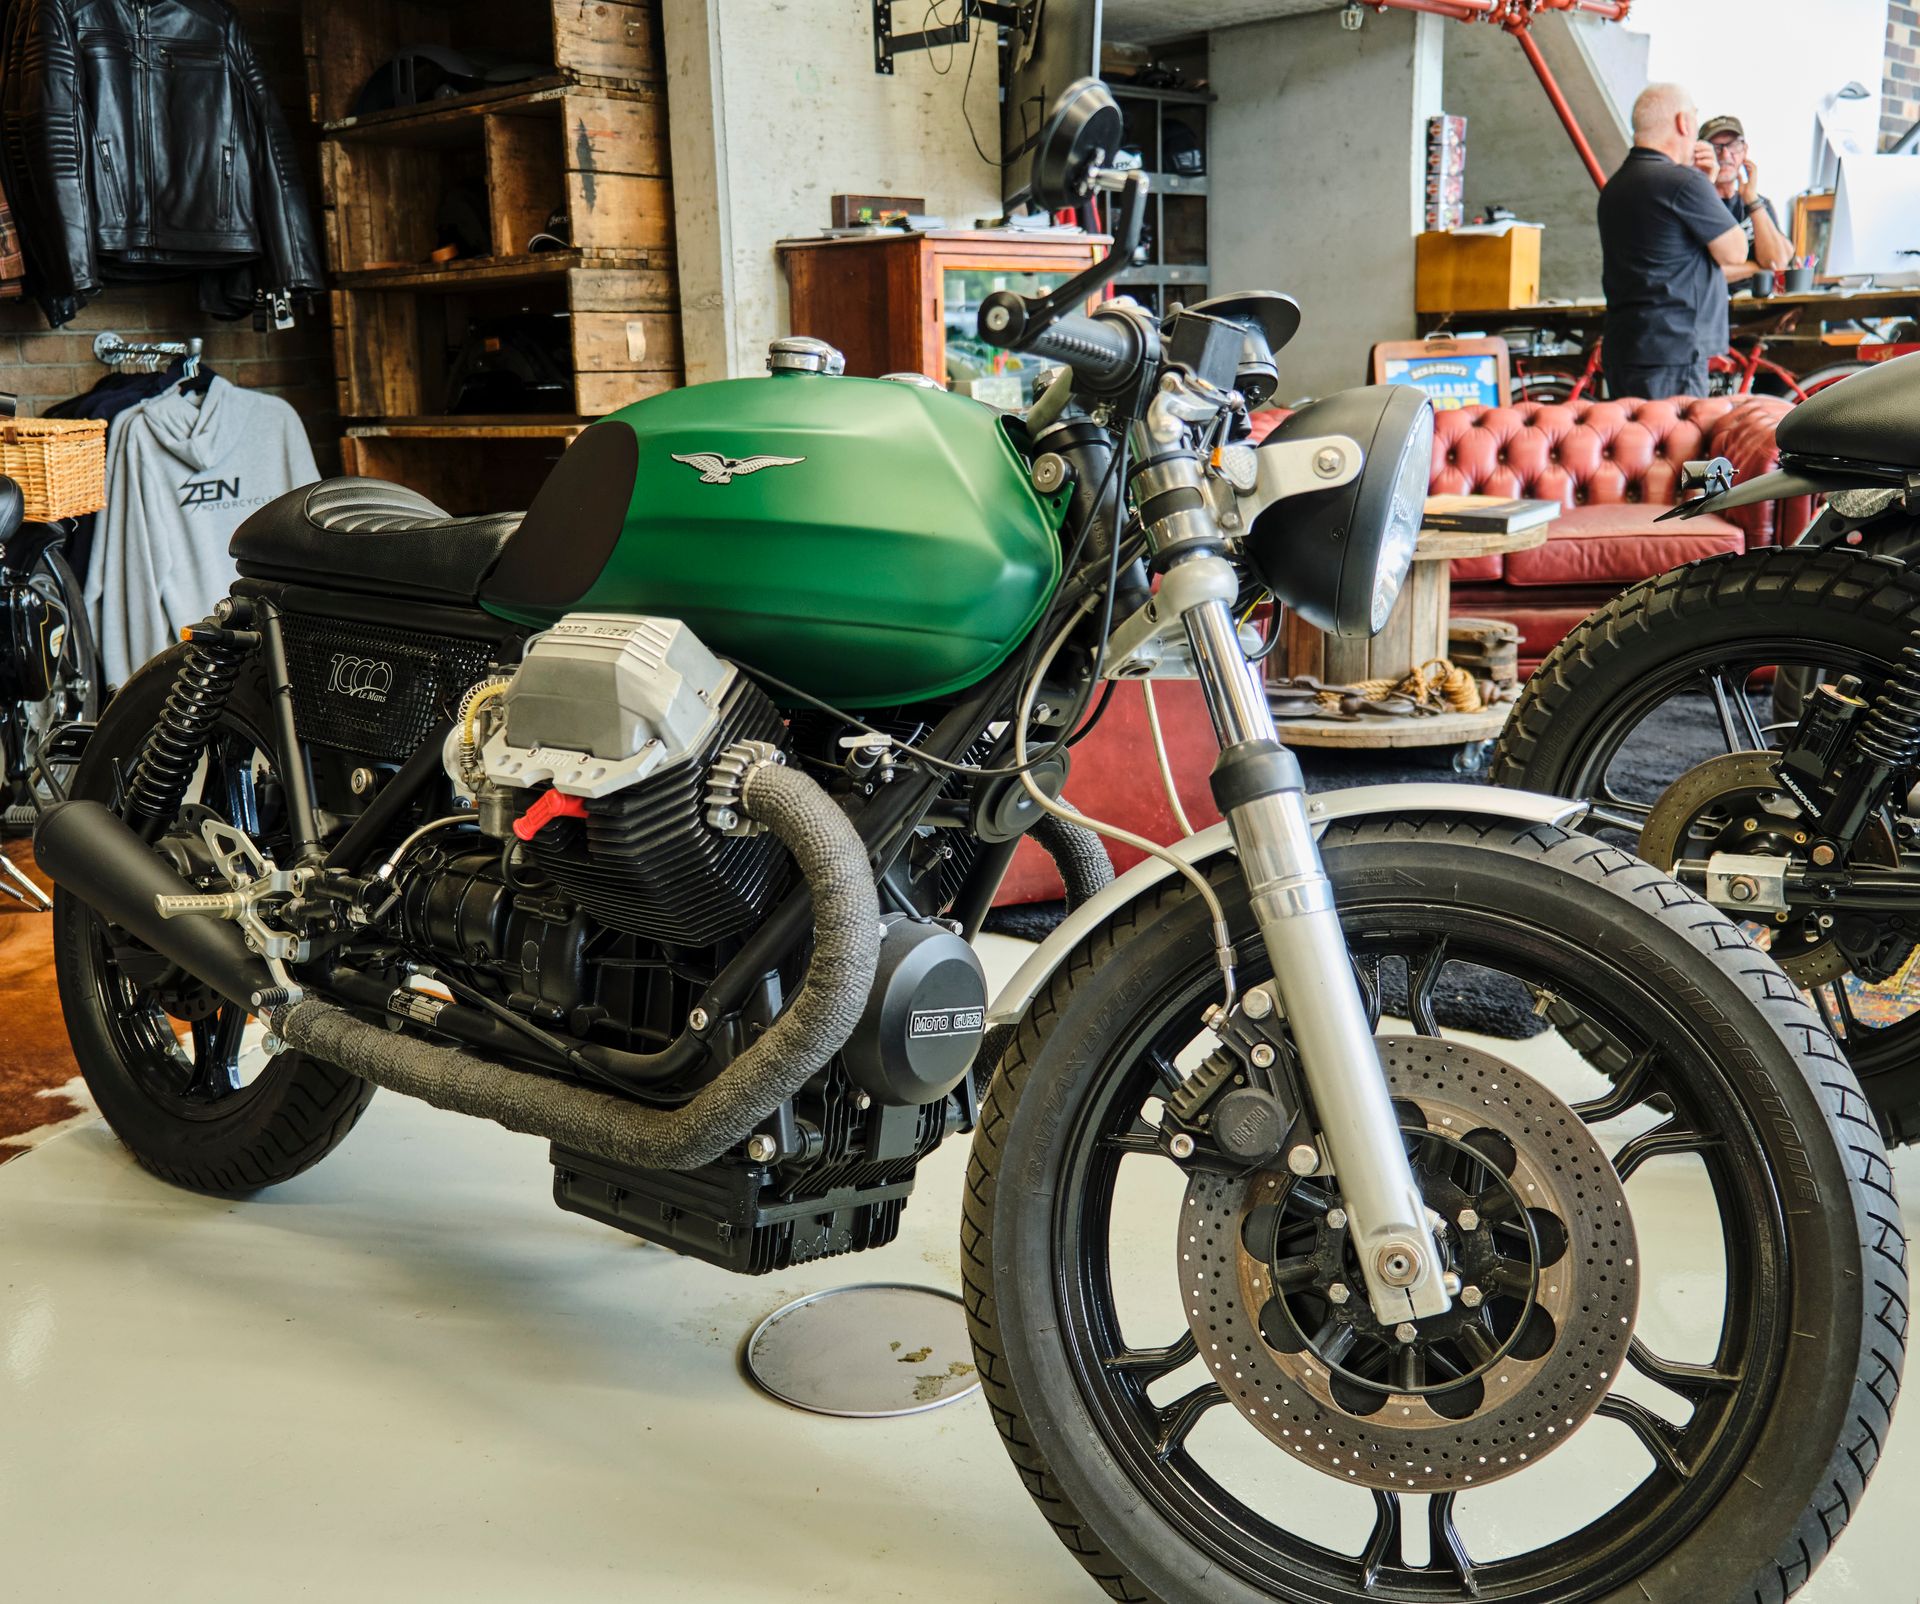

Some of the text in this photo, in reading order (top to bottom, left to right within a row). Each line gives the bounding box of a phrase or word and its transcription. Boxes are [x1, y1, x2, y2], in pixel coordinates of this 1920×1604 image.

[178, 476, 240, 509] ZEN
[557, 625, 632, 638] MOTO GUZZI
[327, 653, 393, 696] 1000
[358, 689, 387, 703] Le Mans
[1779, 772, 1822, 818] MARZOCCHI
[913, 1015, 949, 1032] MOTO
[1622, 943, 1821, 1203] BRIDGESTONE
[1229, 1105, 1270, 1148] BREMBO
